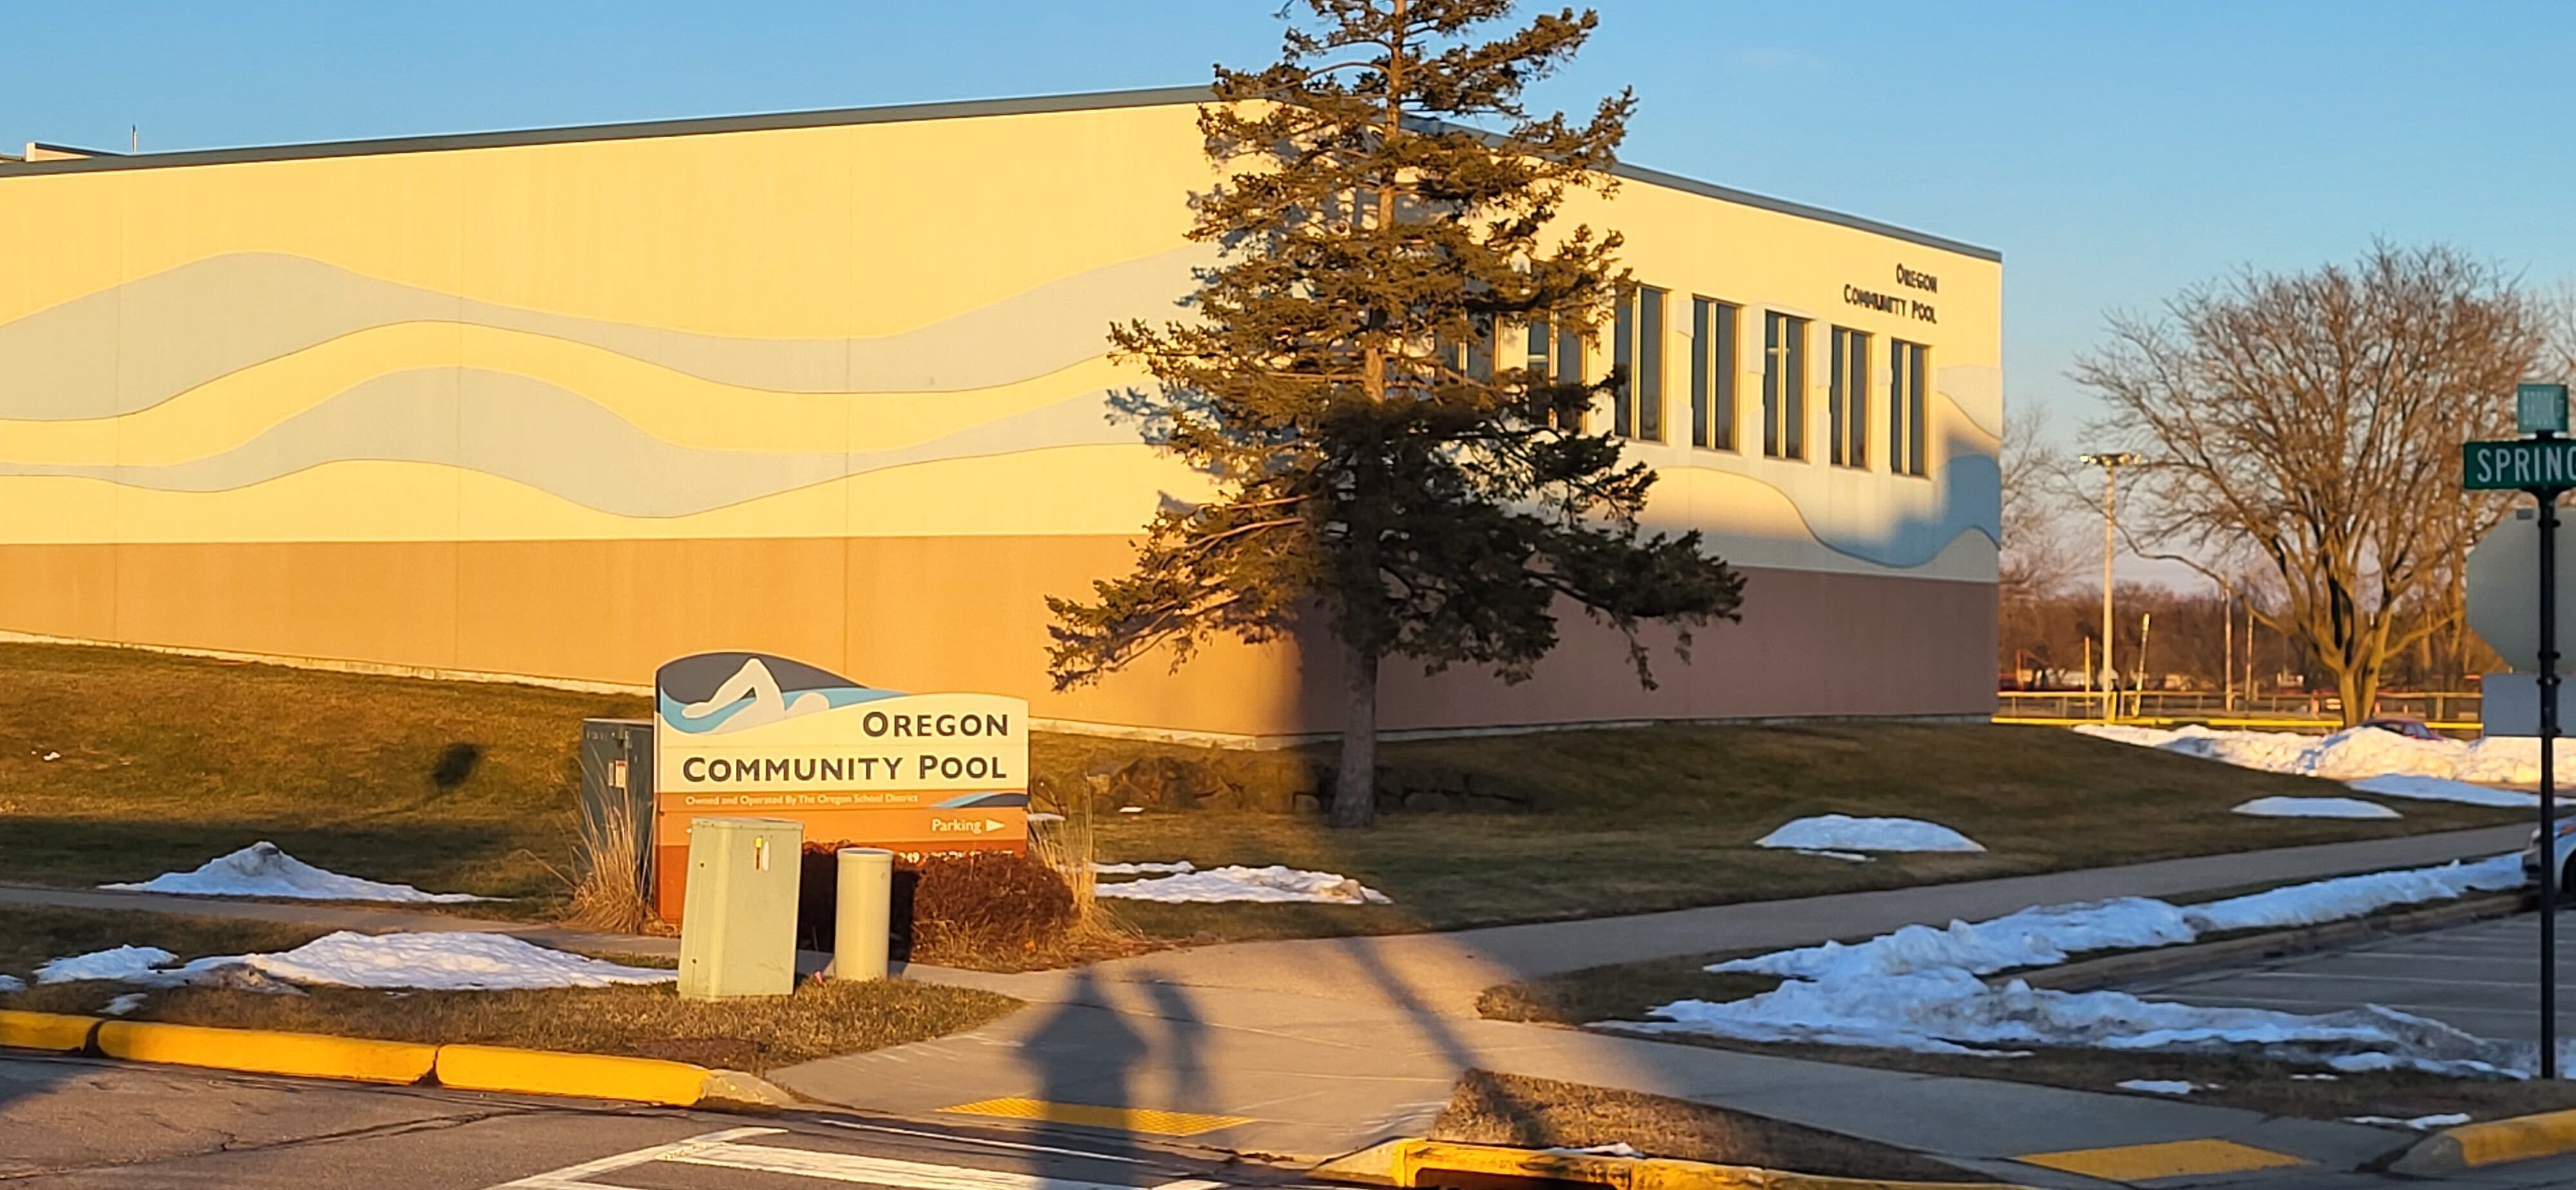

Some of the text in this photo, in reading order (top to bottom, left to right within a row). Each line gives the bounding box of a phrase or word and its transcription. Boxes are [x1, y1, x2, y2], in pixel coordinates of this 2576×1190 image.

[1895, 262, 1938, 294] OREGON
[1844, 283, 1938, 324] COMMUNITY POOL
[862, 710, 1009, 737] OREGON
[683, 755, 1007, 782] COMMUNITY POOL
[685, 793, 918, 807] Owned and Operated By The Oregon School District
[932, 818, 982, 835] Parking
